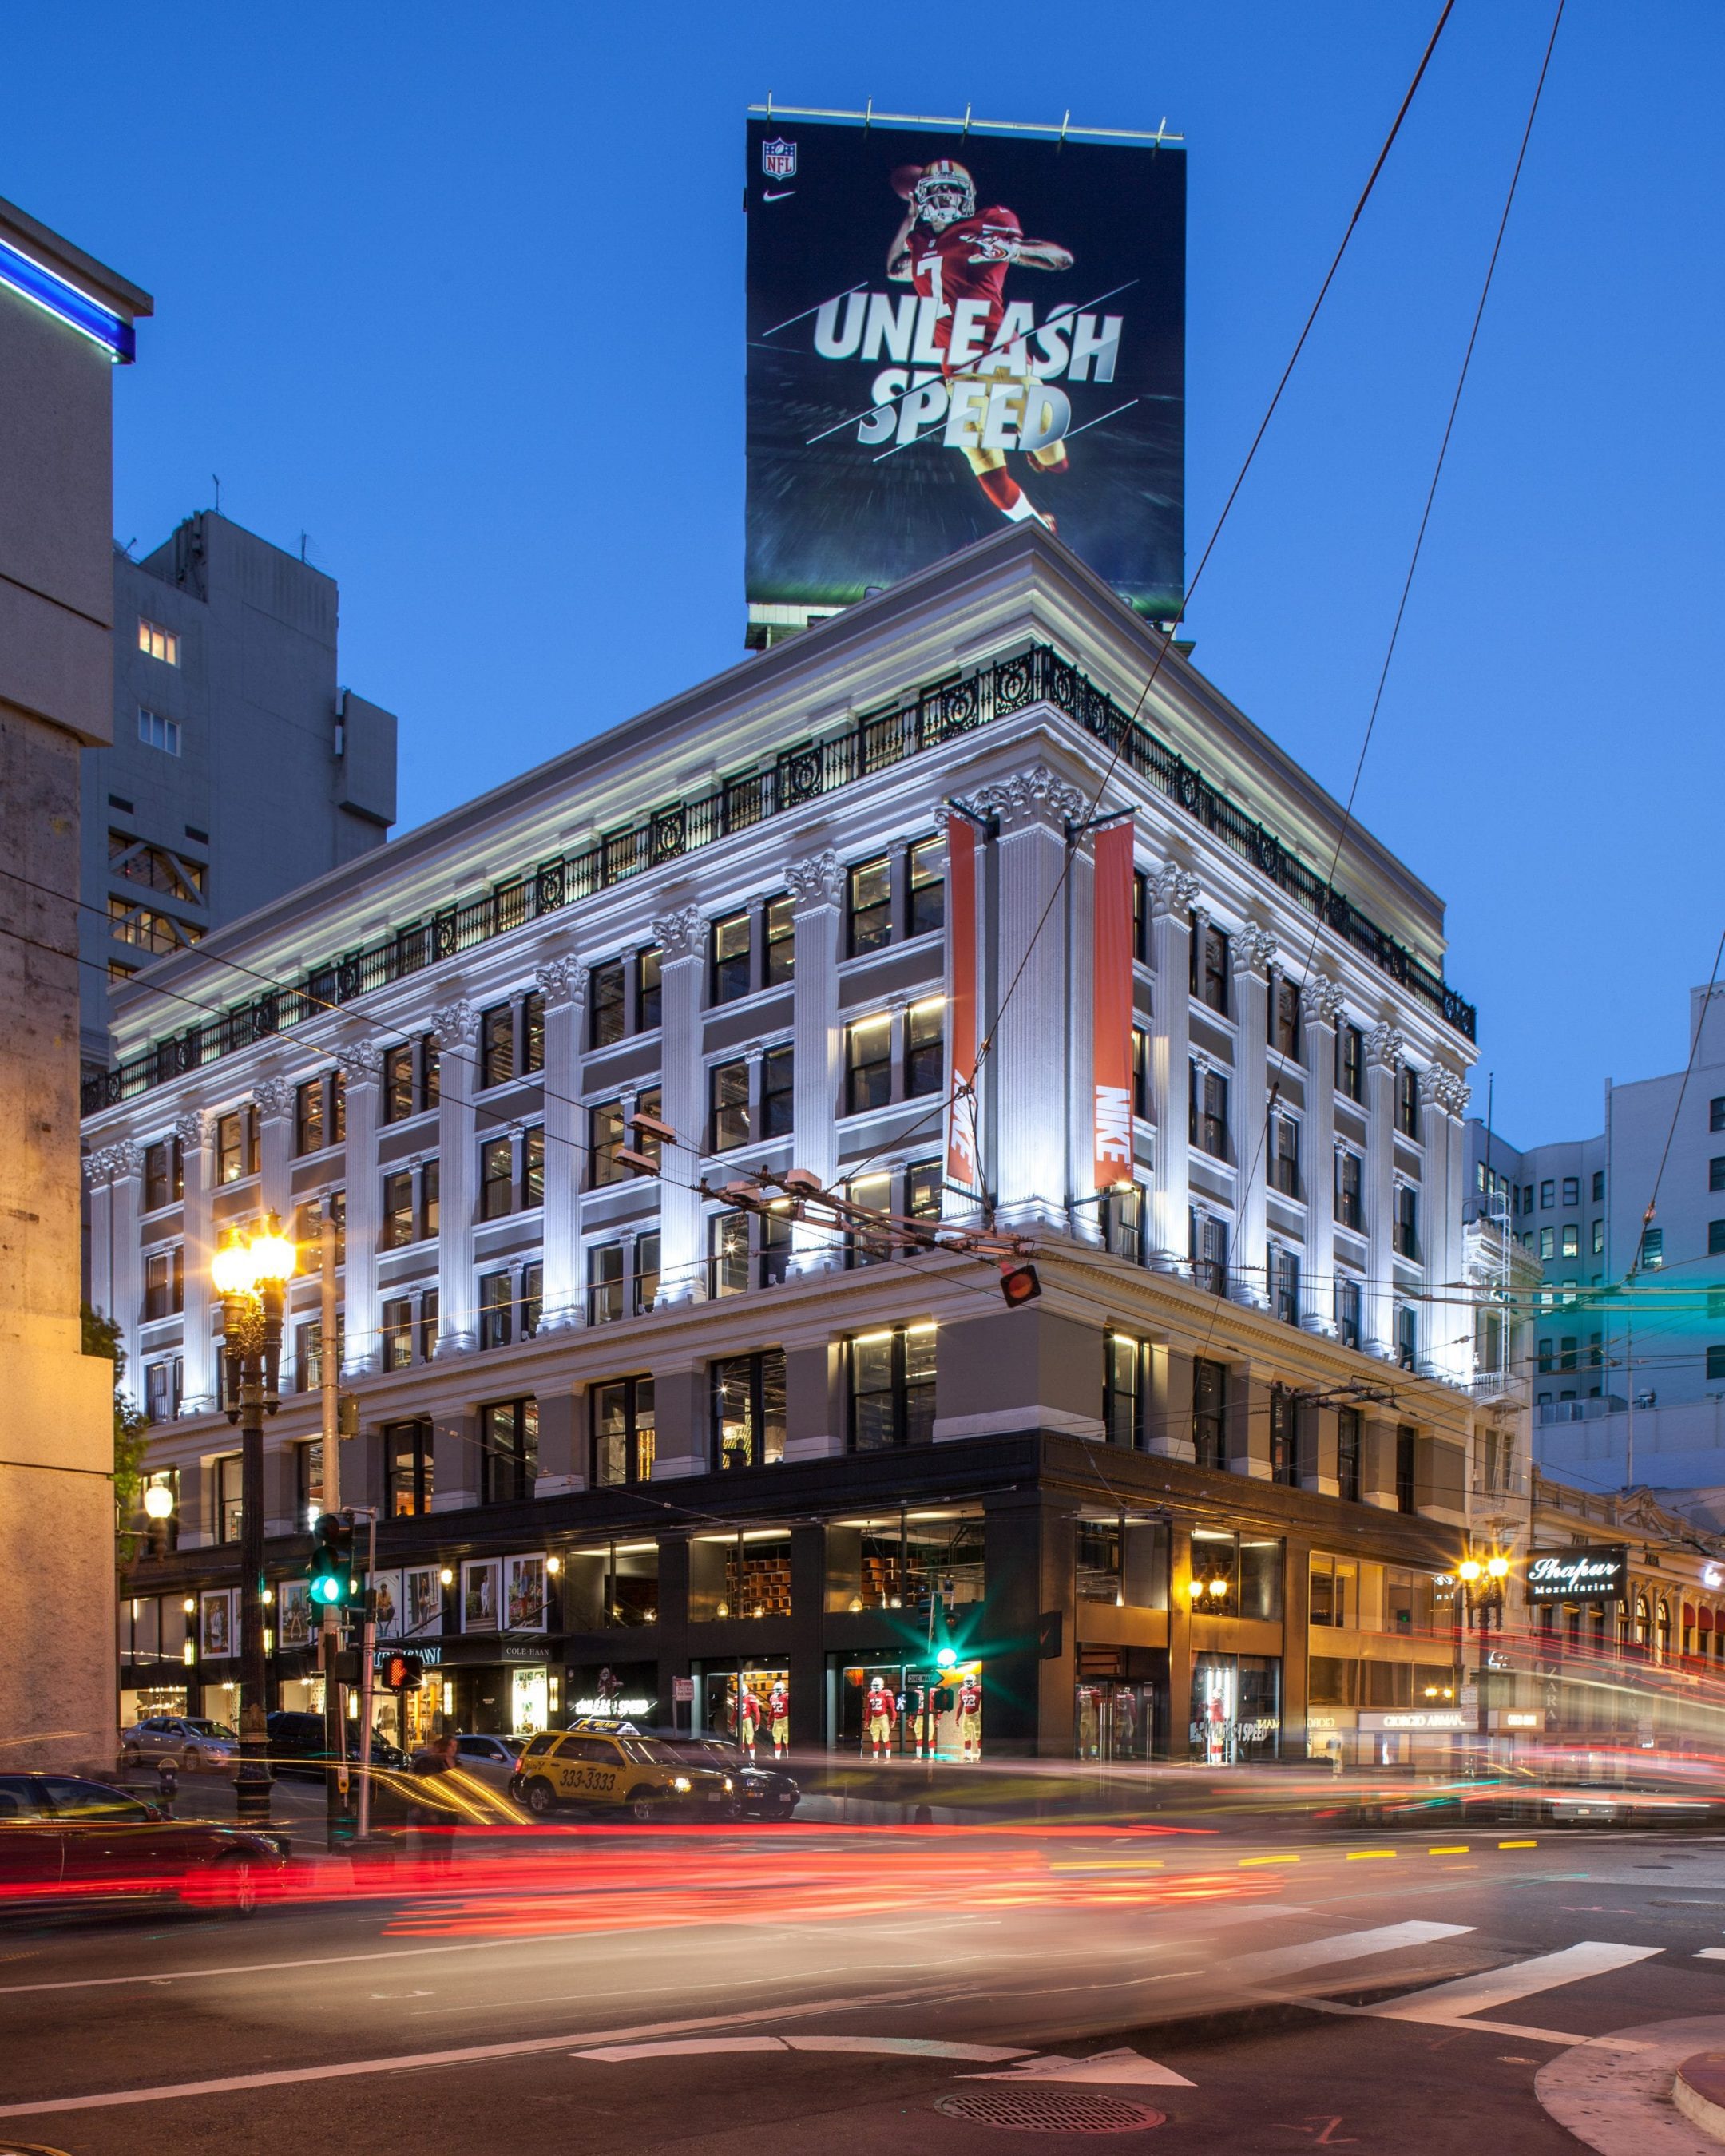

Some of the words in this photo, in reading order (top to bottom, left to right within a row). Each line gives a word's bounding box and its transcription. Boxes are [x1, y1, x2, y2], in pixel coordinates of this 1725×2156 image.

[767, 156, 793, 174] NFL
[916, 256, 951, 318] 7
[813, 291, 1124, 383] UNLEASH
[857, 368, 1072, 451] SPEED
[1096, 1084, 1132, 1165] NIKE
[1528, 1558, 1621, 1587] Shapur
[1533, 1583, 1615, 1595] Mozaffarian
[1545, 1666, 1558, 1720] ZARA
[1426, 1714, 1466, 1727] ARMAN
[560, 1769, 616, 1791] 333-3333
